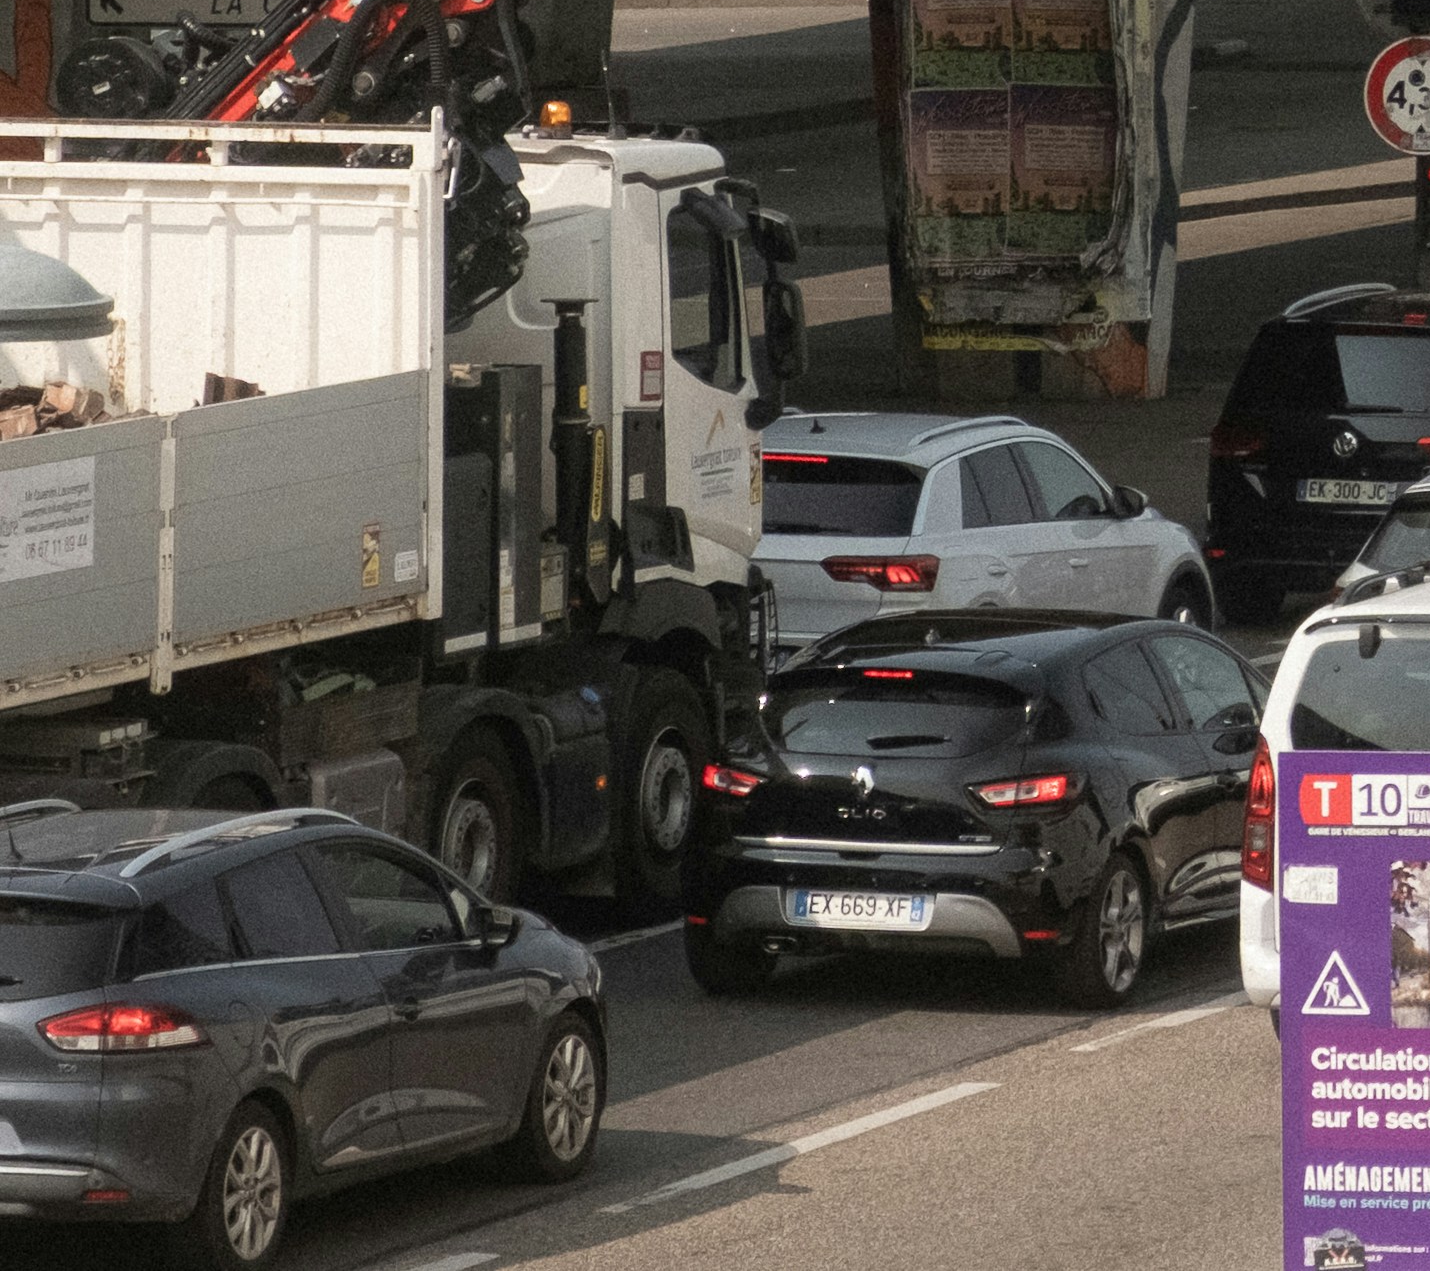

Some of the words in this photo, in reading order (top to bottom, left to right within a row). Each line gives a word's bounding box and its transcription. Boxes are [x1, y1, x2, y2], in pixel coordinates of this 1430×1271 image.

[1308, 480, 1386, 501] EK-300-JC
[837, 807, 887, 821] CLIO
[1308, 827, 1329, 836] GARE
[808, 893, 910, 918] EX-669-XF
[1311, 1110, 1352, 1129] sur
[1357, 1106, 1379, 1130] le
[1303, 1195, 1334, 1209] Mise
[1339, 1198, 1357, 1209] en
[1360, 1196, 1409, 1210] service
